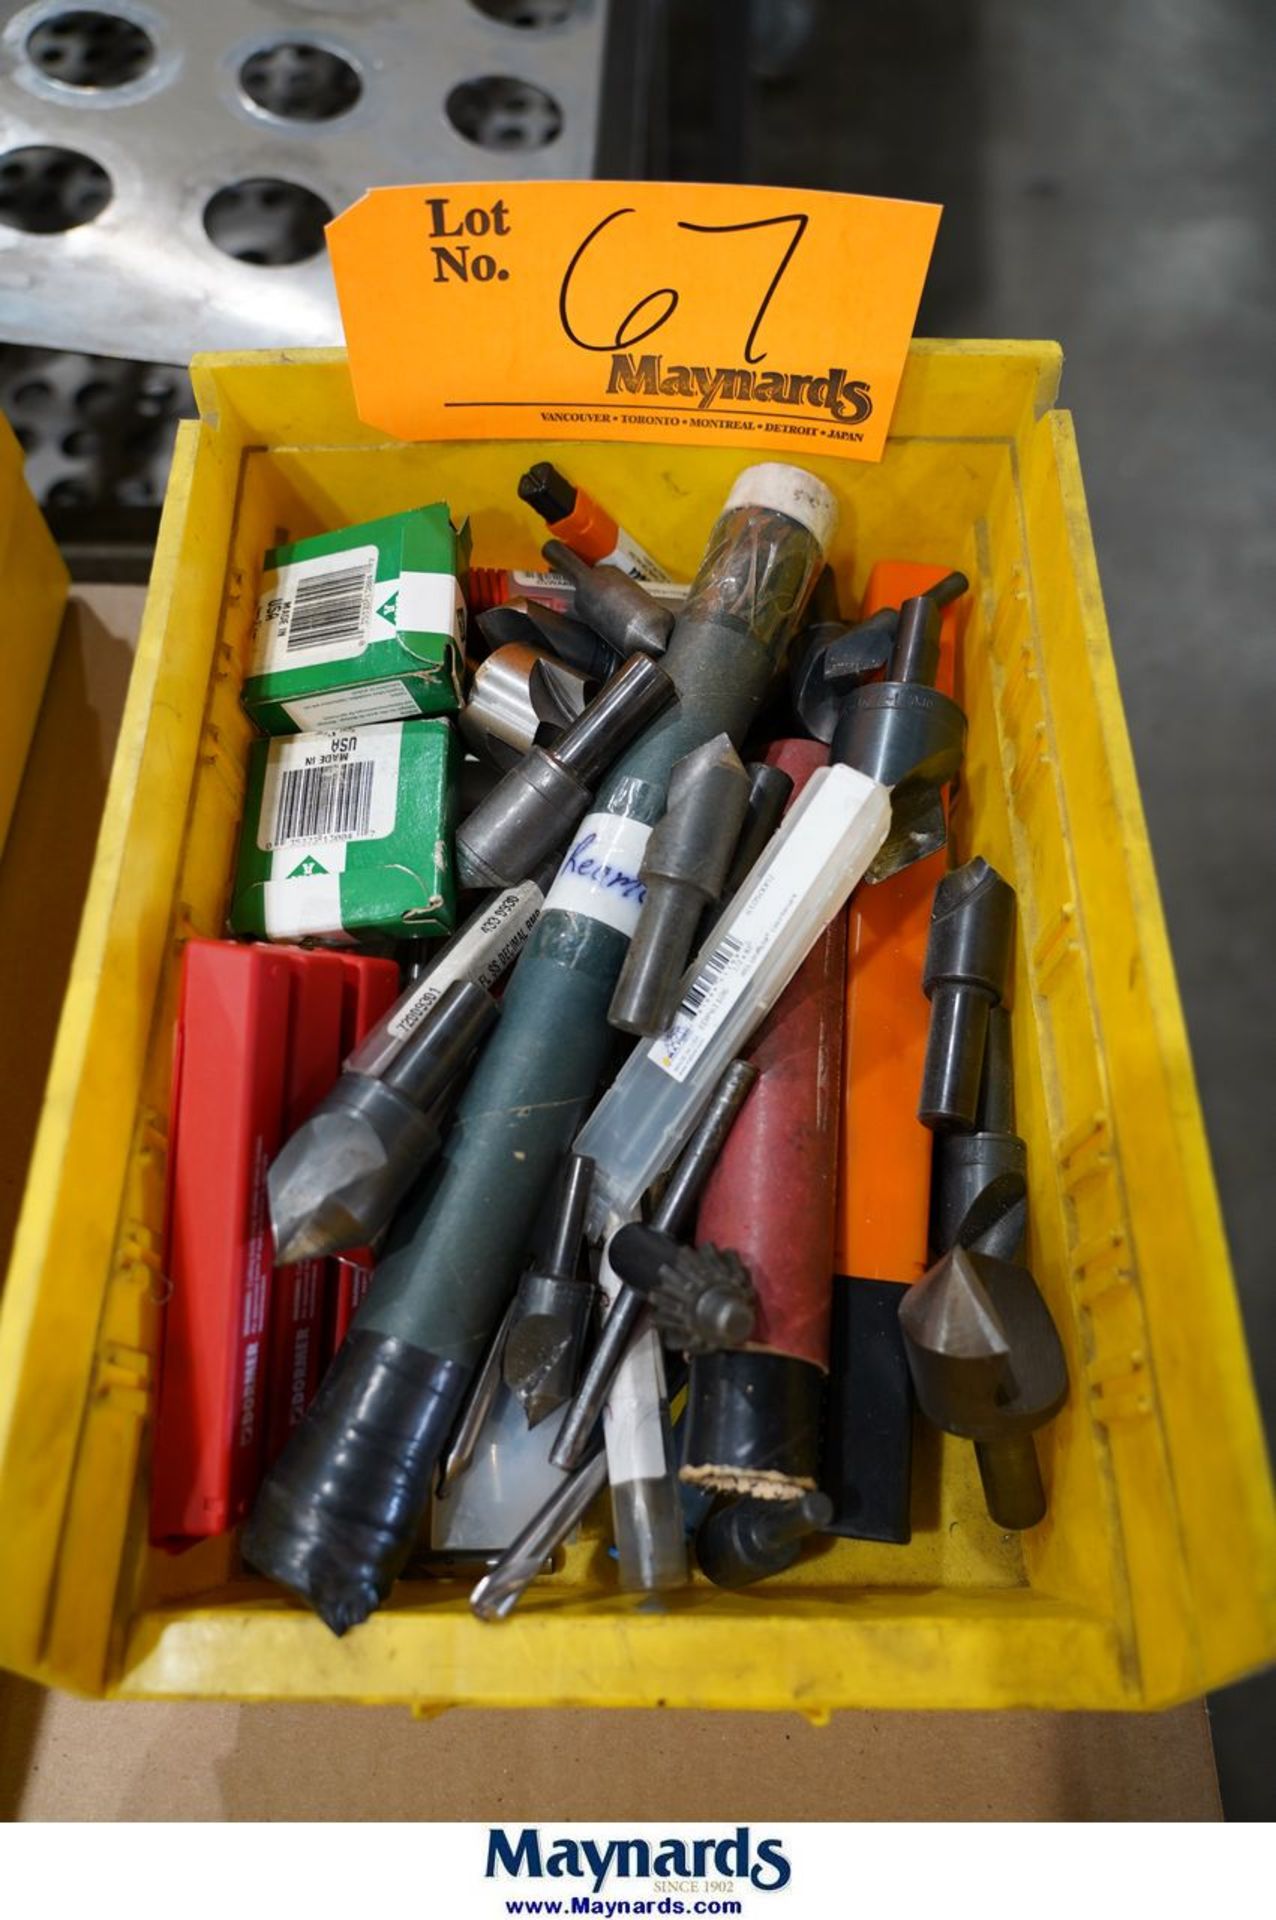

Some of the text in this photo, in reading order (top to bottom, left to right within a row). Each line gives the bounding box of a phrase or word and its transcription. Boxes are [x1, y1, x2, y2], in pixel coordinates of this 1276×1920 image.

[426, 198, 511, 238] Lot
[431, 246, 510, 284] No.
[559, 208, 809, 364] 67
[605, 353, 875, 426] Maynards
[541, 411, 865, 443] VANCOUVER TORONTO MONTREAL DETROIT JAPAN
[265, 598, 283, 623] USA
[305, 753, 349, 766] MADE IN
[331, 736, 358, 753] USA
[480, 894, 520, 935] 433 0930
[498, 929, 529, 965] DECIMAL
[396, 986, 442, 1033] 72009301
[241, 1342, 259, 1426] DORMER
